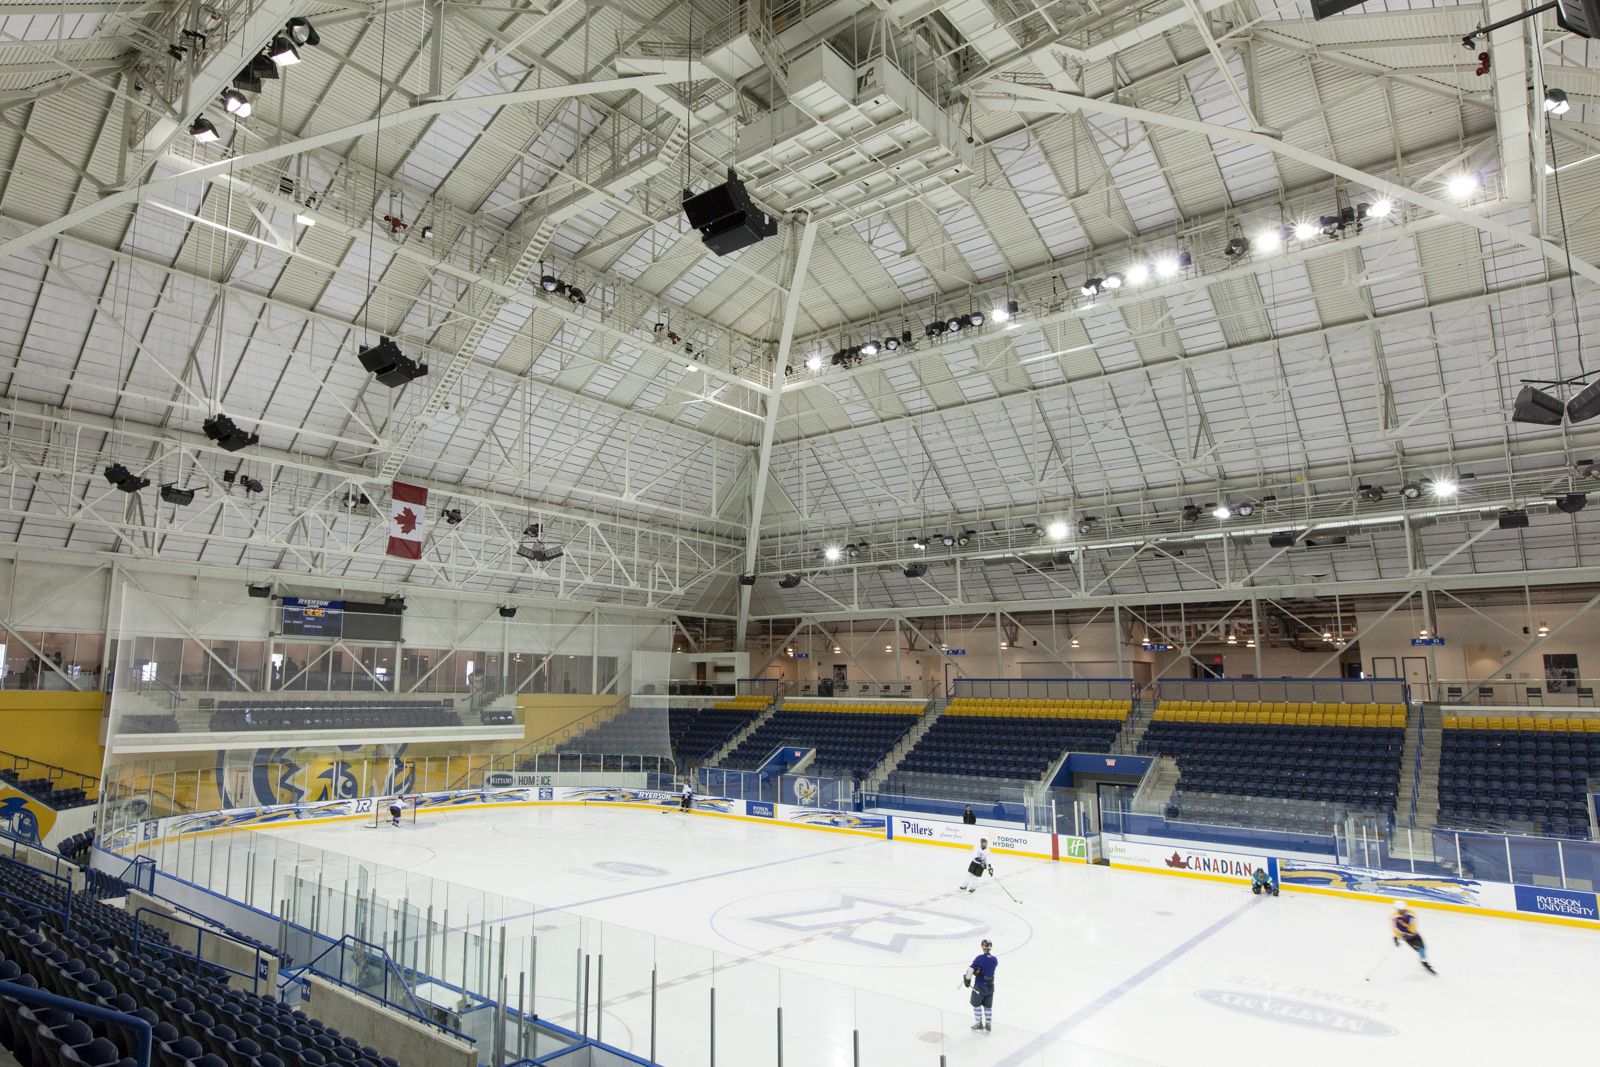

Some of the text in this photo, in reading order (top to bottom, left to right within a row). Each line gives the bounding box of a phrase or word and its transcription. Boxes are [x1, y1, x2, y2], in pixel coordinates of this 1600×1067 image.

[298, 598, 329, 606] RYERSON
[518, 776, 539, 786] HOME
[541, 776, 551, 786] ICE
[638, 791, 672, 800] RYERSON
[356, 798, 373, 813] R
[901, 820, 933, 836] Piller's
[992, 841, 1015, 849] HYDRO
[996, 835, 1028, 845] TORONTO
[1114, 845, 1126, 853] Inn
[1187, 855, 1252, 877] CANADIAN
[1536, 895, 1581, 907] RYERSON
[1537, 902, 1595, 916] UNIVERSITY
